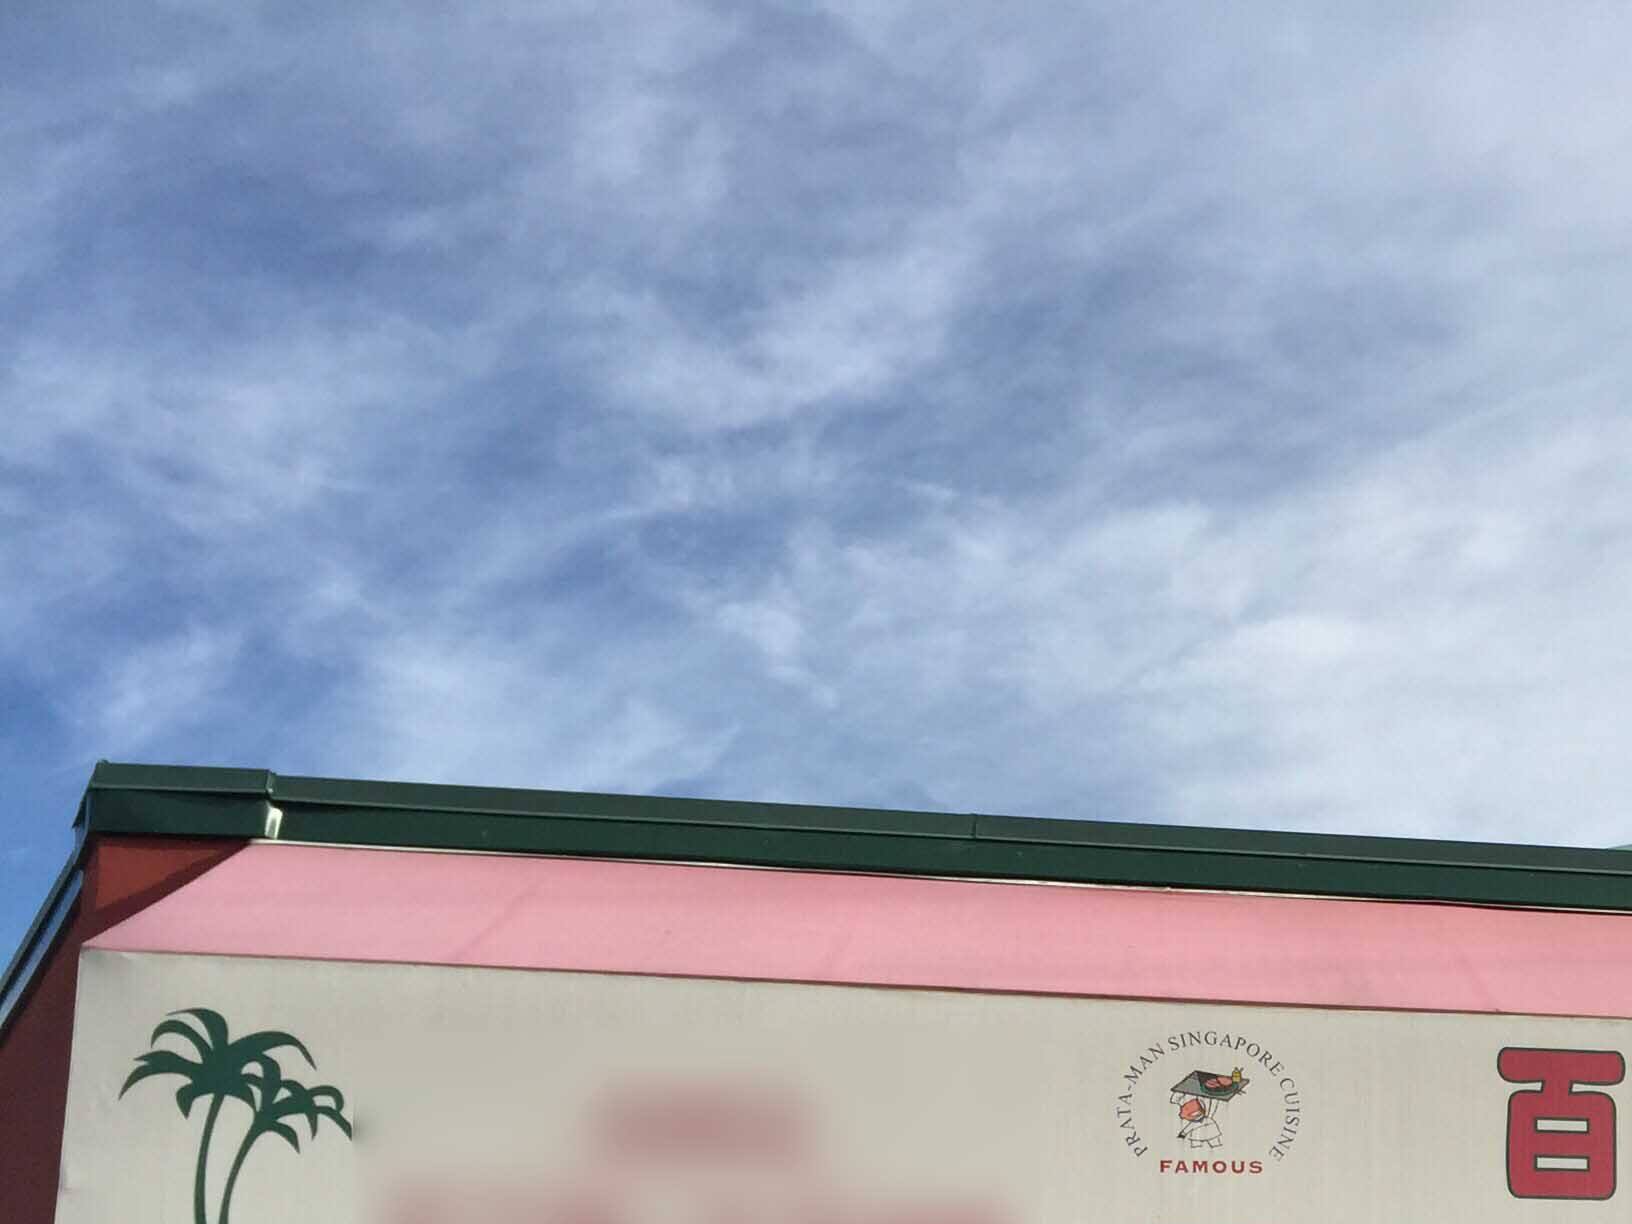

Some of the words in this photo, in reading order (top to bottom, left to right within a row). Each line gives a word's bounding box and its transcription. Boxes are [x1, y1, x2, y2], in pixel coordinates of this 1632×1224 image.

[1116, 1042, 1166, 1158] PRATA-MAN
[1167, 1030, 1285, 1077] SINGAPORE
[1268, 1077, 1301, 1162] CUISINE
[1159, 1159, 1264, 1175] FAMOUS
